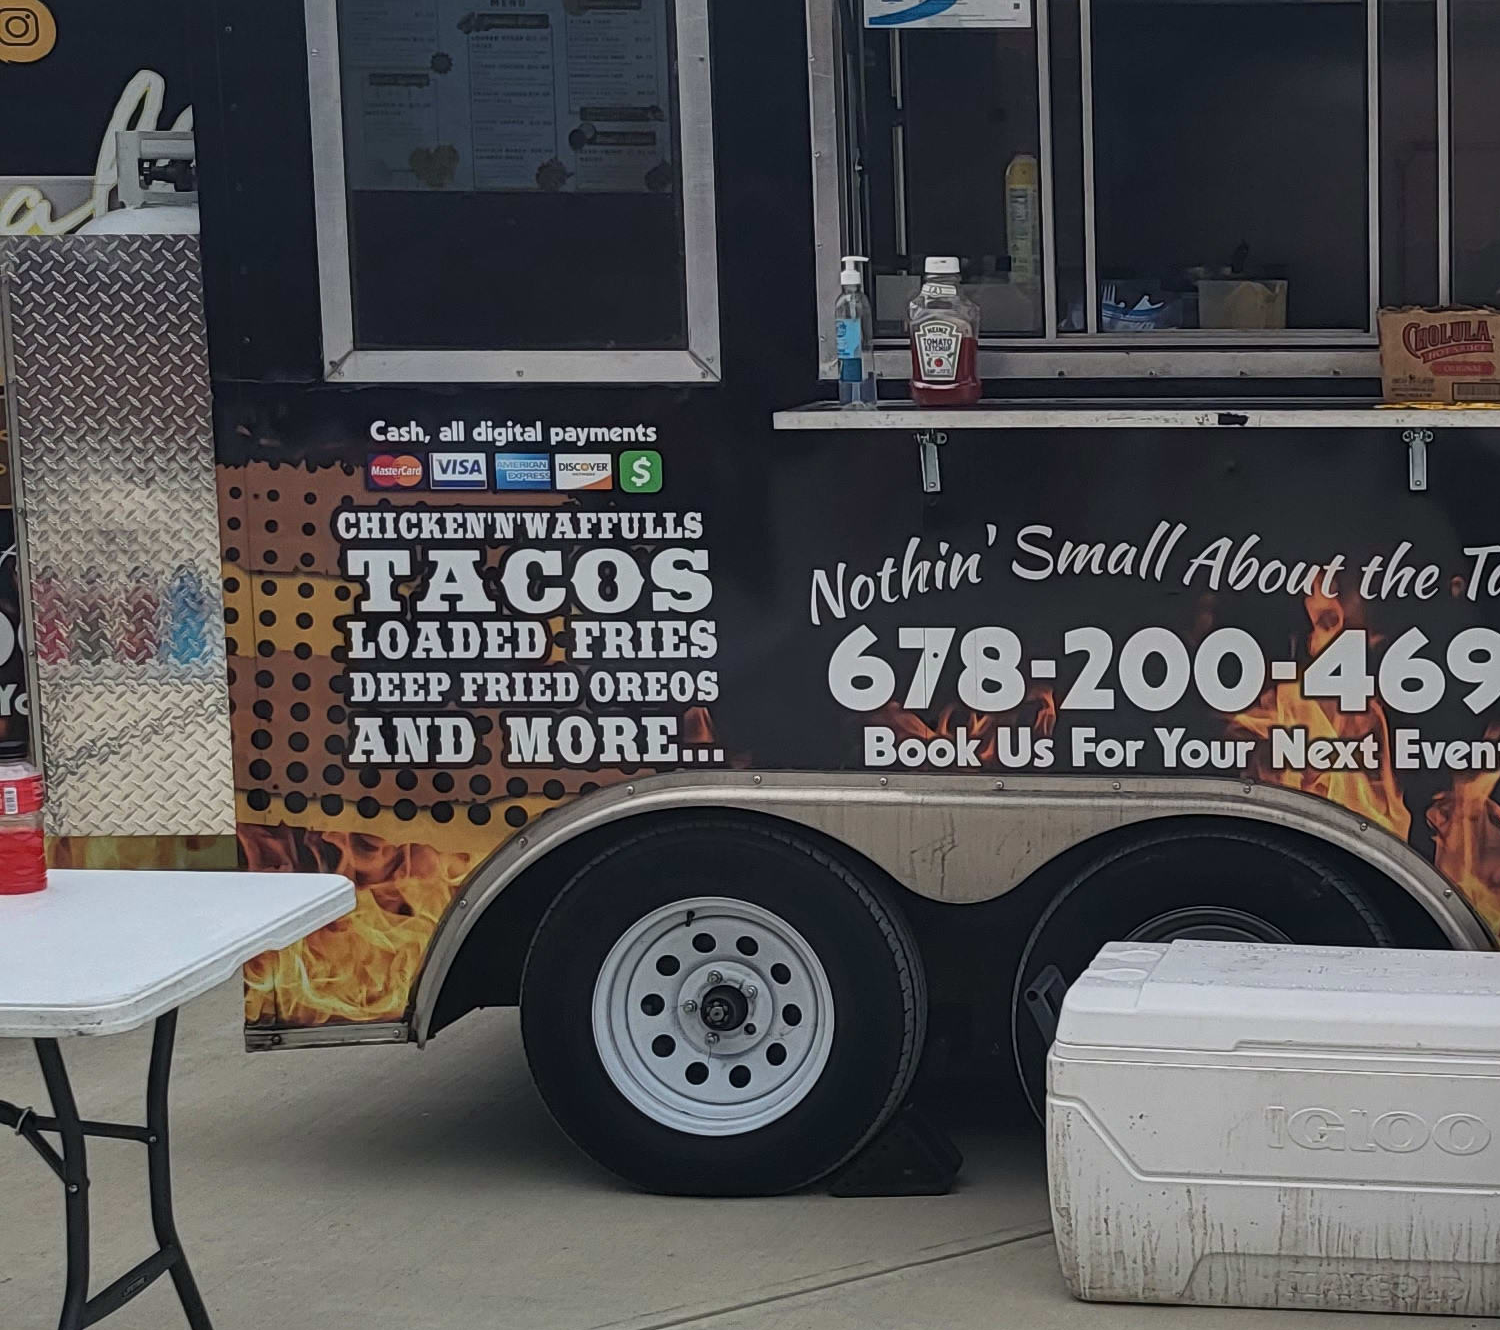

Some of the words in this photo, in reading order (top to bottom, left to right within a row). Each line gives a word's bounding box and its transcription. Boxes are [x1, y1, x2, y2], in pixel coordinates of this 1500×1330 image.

[923, 338, 953, 346] TOMATO
[1402, 321, 1492, 360] CHOLULA
[370, 421, 431, 444] Cash,
[438, 421, 467, 442] all
[472, 421, 543, 446] digital
[549, 423, 657, 446] payments
[371, 465, 422, 477] MasterCard
[437, 459, 483, 475] VISA
[497, 461, 547, 470] AMERICAN
[507, 472, 551, 480] EXPRESS
[558, 462, 609, 472] DISCOVER
[346, 549, 711, 614] TACOS
[810, 522, 998, 627] Nothin'
[1010, 520, 1187, 583] Small
[1182, 534, 1342, 599] About
[1358, 540, 1441, 601] the
[347, 620, 546, 659] LOADED
[571, 620, 718, 659] FRIES
[349, 671, 451, 703] DEEP
[461, 671, 579, 703] FRIED
[589, 671, 719, 703] OREOS
[347, 716, 477, 764] AND
[504, 716, 725, 763] MORE...
[862, 725, 982, 770] Book
[998, 725, 1055, 769] Us
[1071, 727, 1142, 769] For
[1154, 727, 1255, 770] Your
[1272, 727, 1380, 770] Next
[1265, 1105, 1492, 1156] IGLOO
